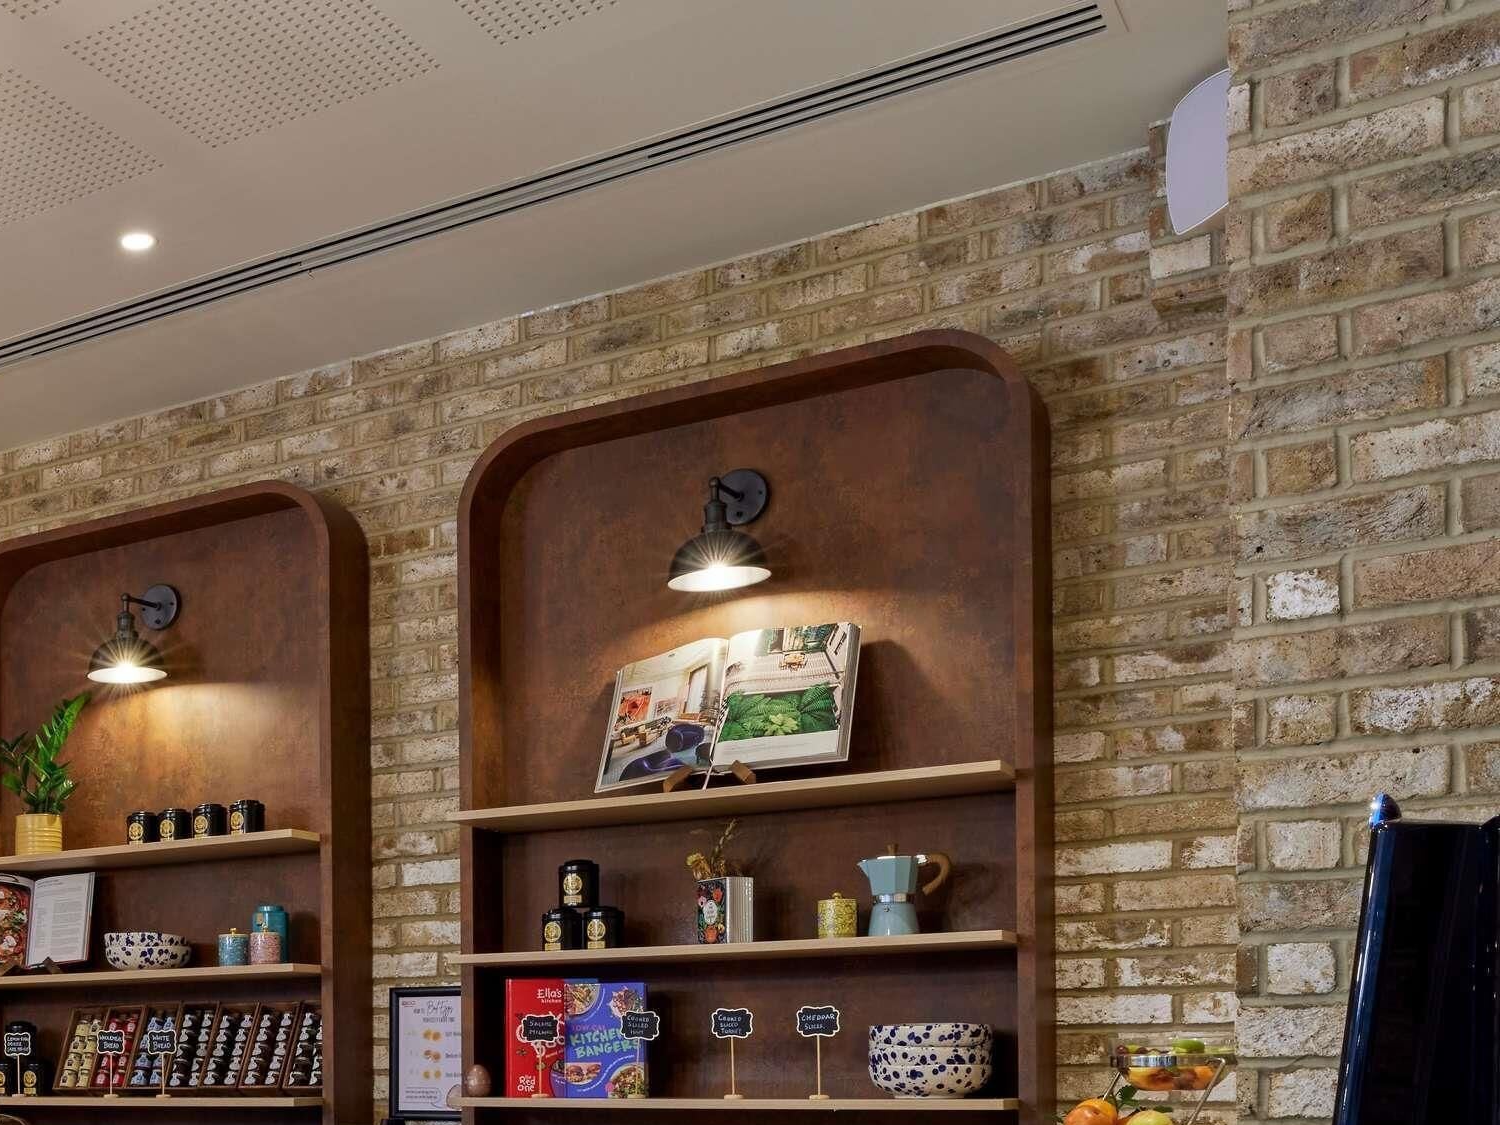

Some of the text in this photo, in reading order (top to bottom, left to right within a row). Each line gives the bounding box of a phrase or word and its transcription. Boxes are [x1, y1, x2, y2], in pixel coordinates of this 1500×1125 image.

[536, 988, 562, 999] Ella's
[801, 1013, 835, 1021] CHEDDAR
[519, 1075, 536, 1085] Red
